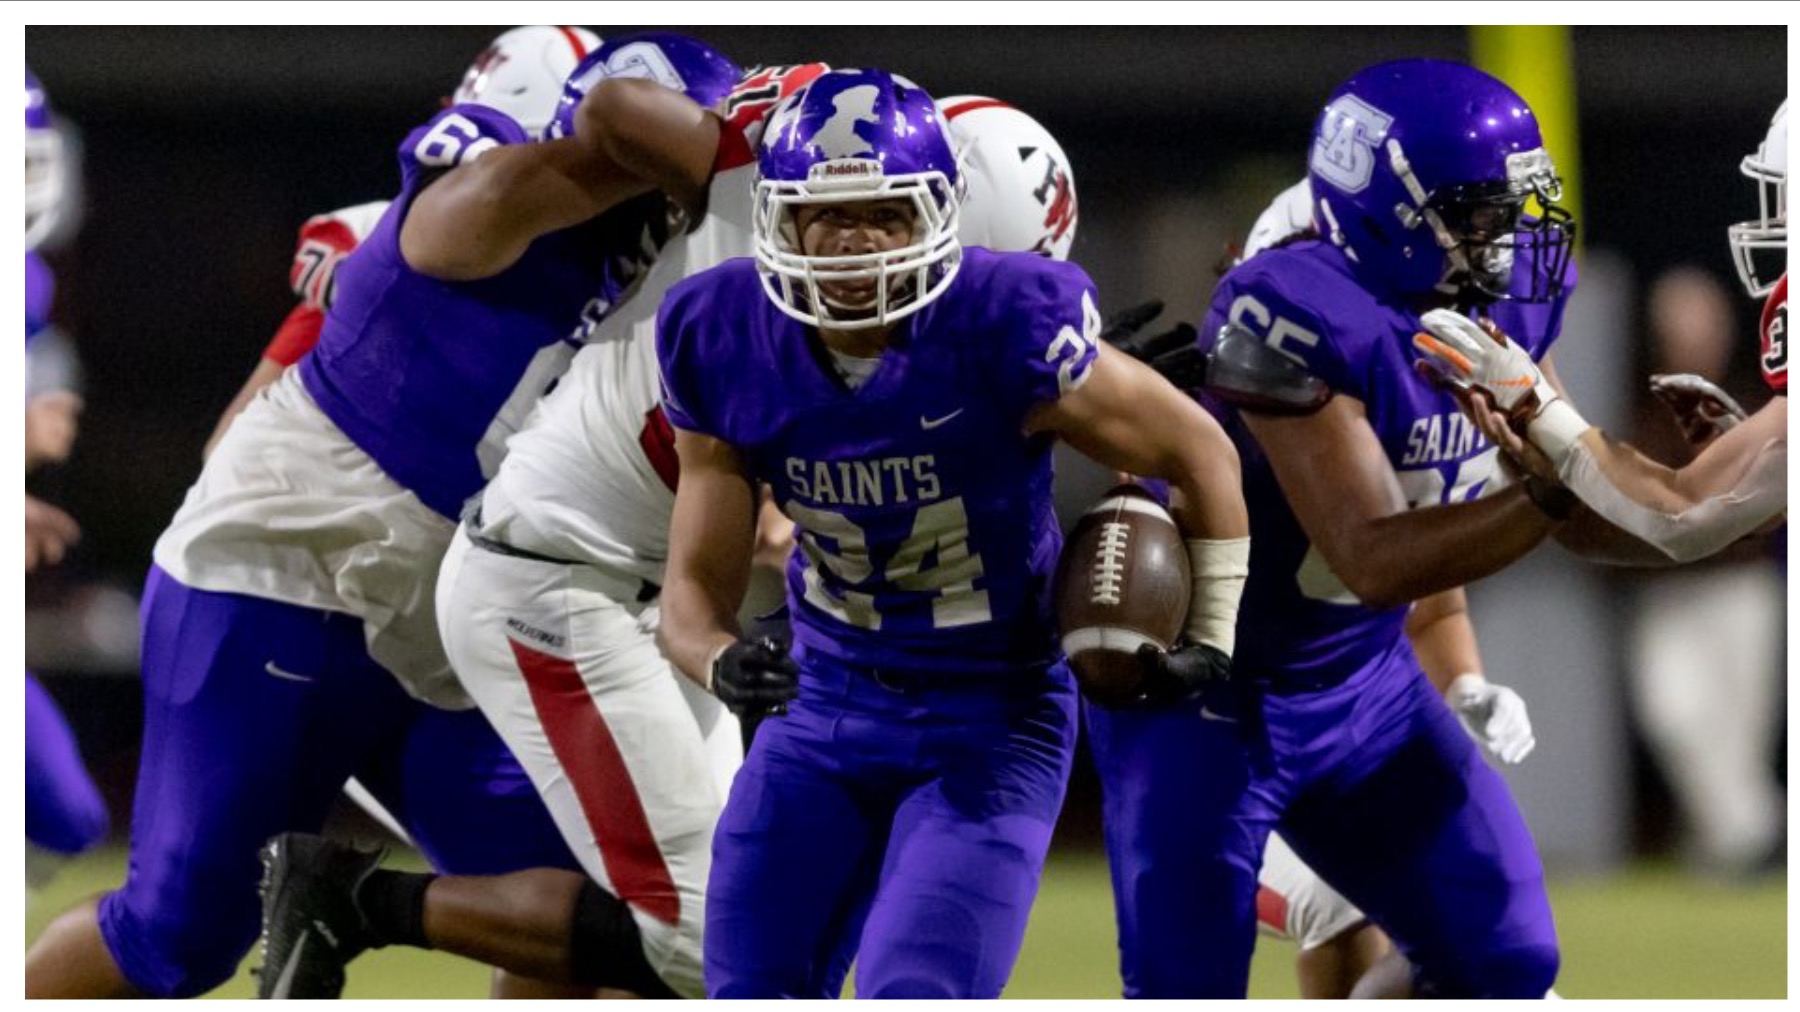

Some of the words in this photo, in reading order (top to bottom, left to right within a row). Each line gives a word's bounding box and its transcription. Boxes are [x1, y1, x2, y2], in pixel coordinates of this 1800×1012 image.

[825, 163, 869, 175] Riddell
[786, 453, 942, 507] SAINTS
[786, 496, 993, 632] 24
